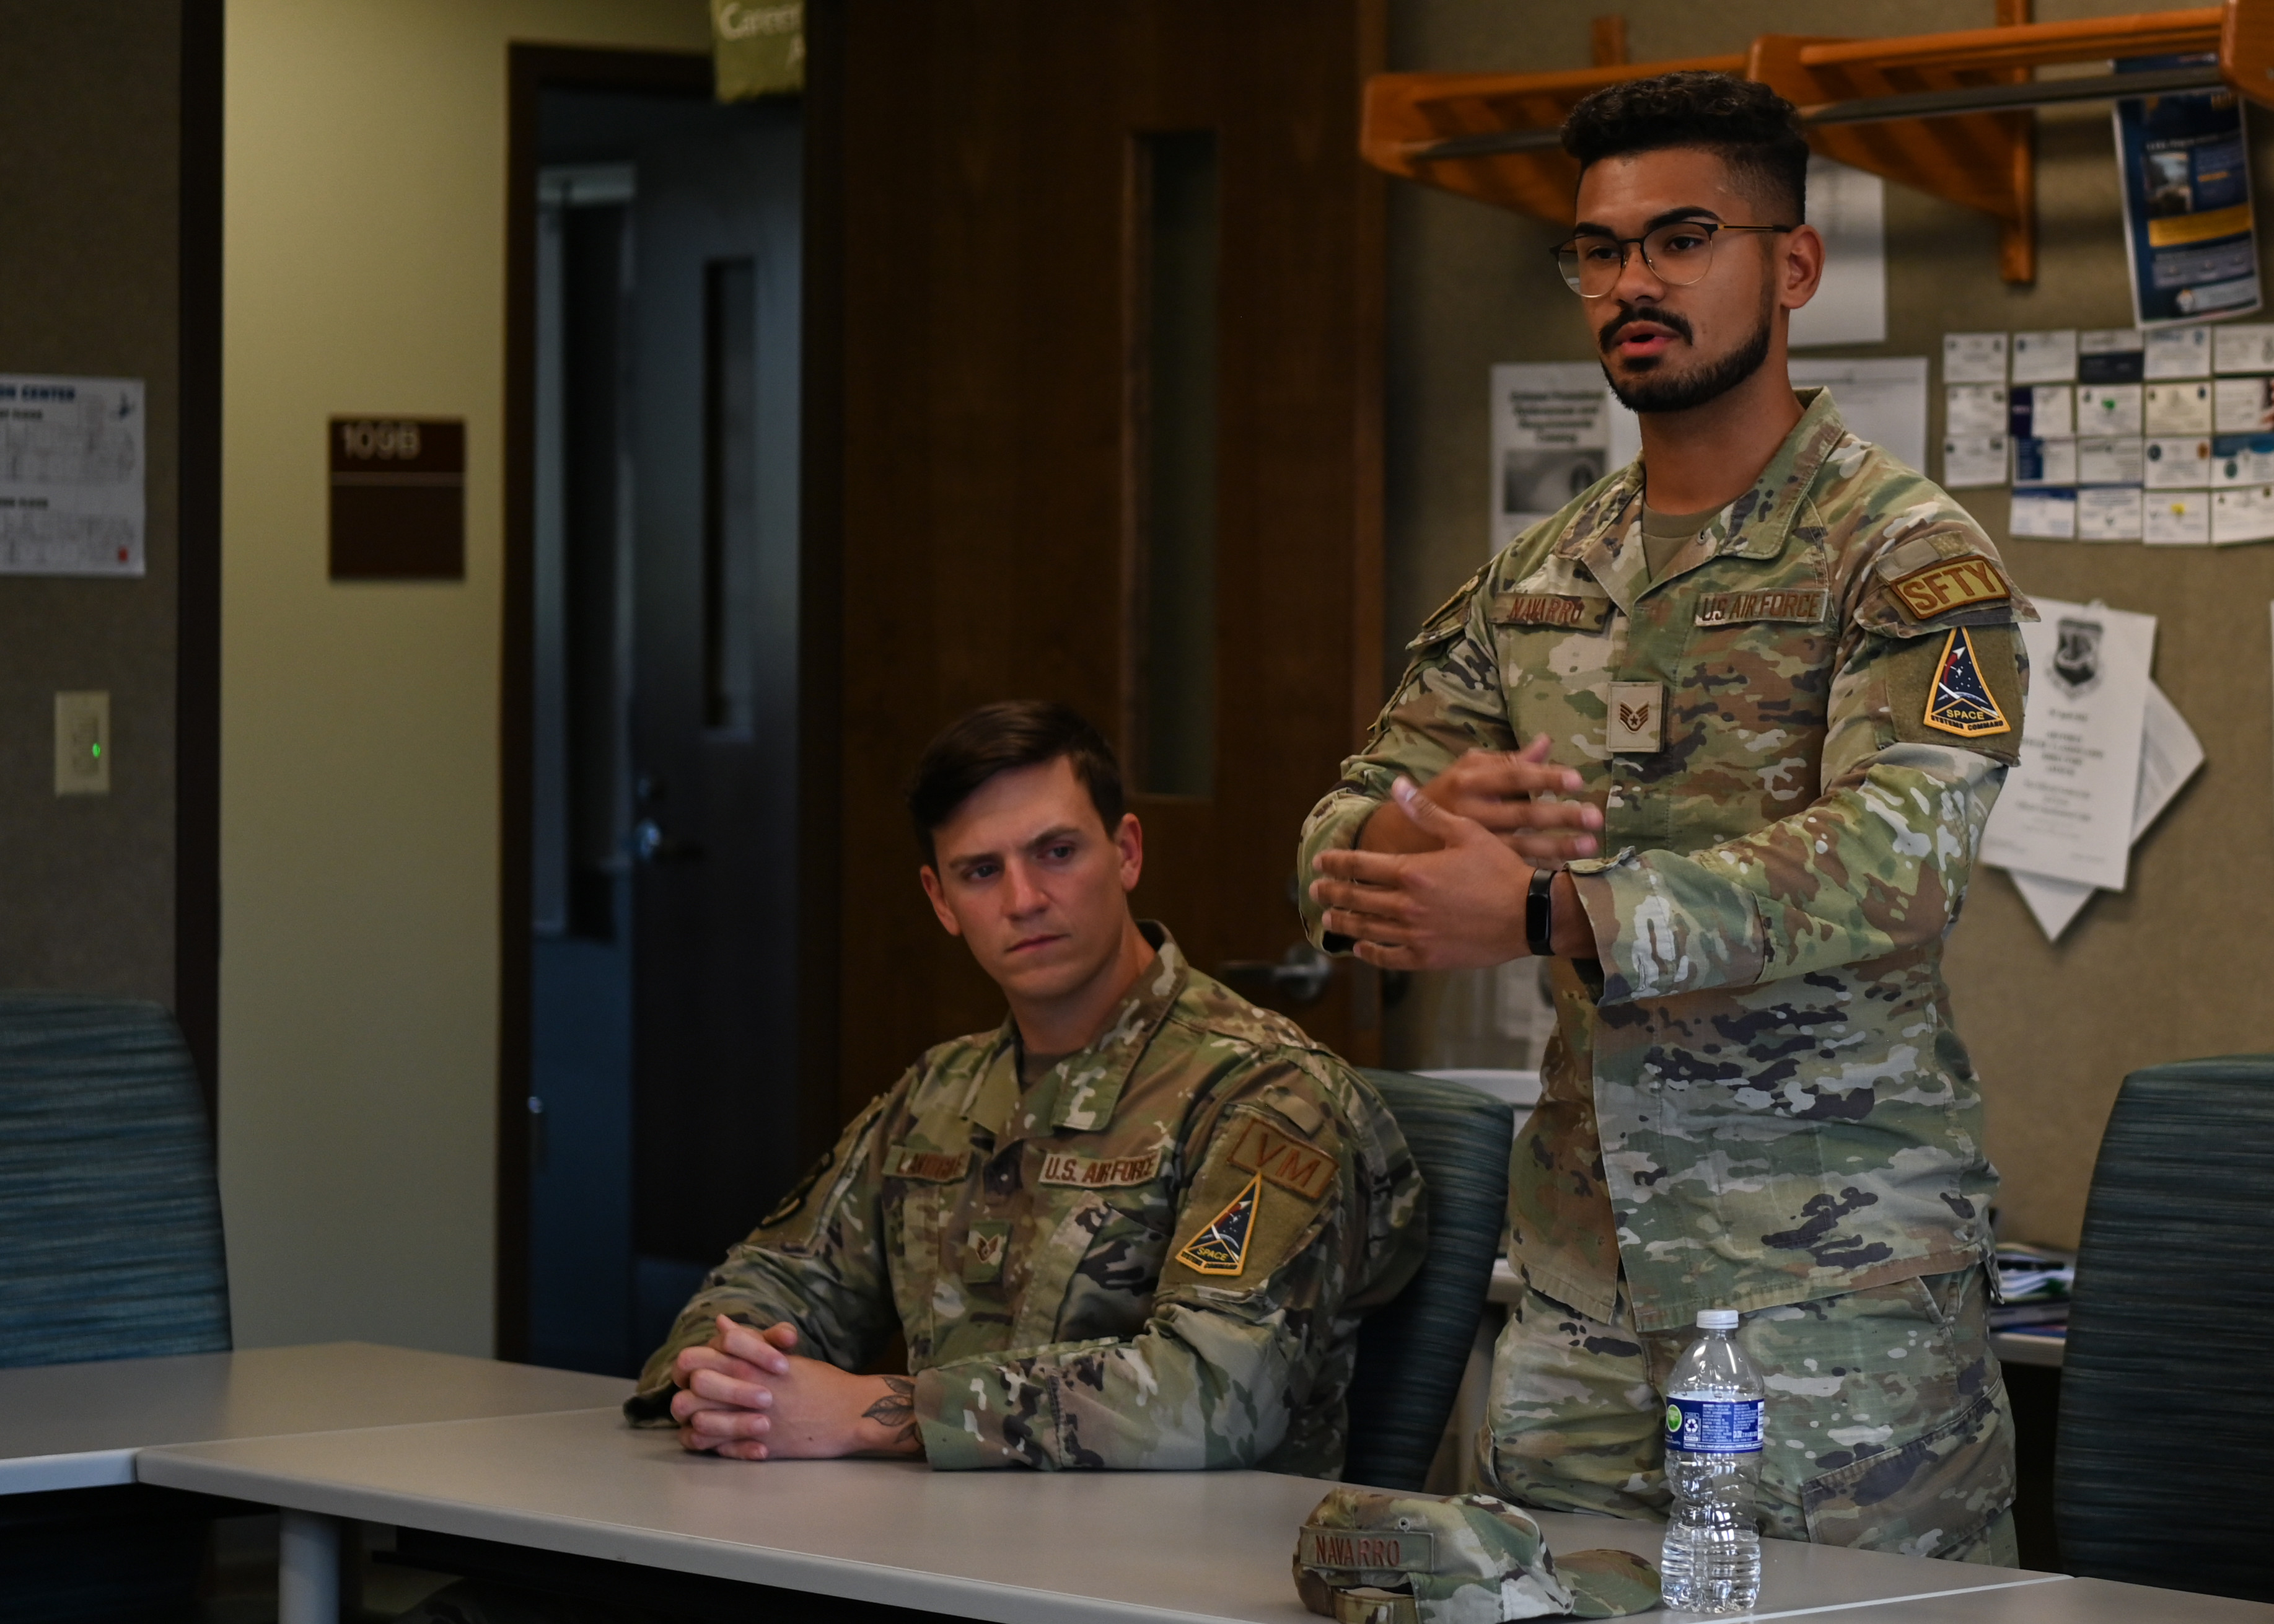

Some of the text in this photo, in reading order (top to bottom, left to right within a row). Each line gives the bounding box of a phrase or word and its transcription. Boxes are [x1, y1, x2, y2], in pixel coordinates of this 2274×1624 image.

[1903, 561, 1997, 610] SFTY
[1508, 595, 1583, 623] NAVARRO
[1732, 594, 1757, 619] AIR
[1757, 591, 1821, 618] FORCE
[1946, 709, 1985, 721] SPACE
[1967, 720, 2004, 731] COMMAND
[1045, 1153, 1156, 1183] U.S. AIR FORCE
[1256, 1133, 1322, 1188] VM
[1196, 1247, 1228, 1262] SPACE
[1315, 1534, 1401, 1568] NAVARRO
